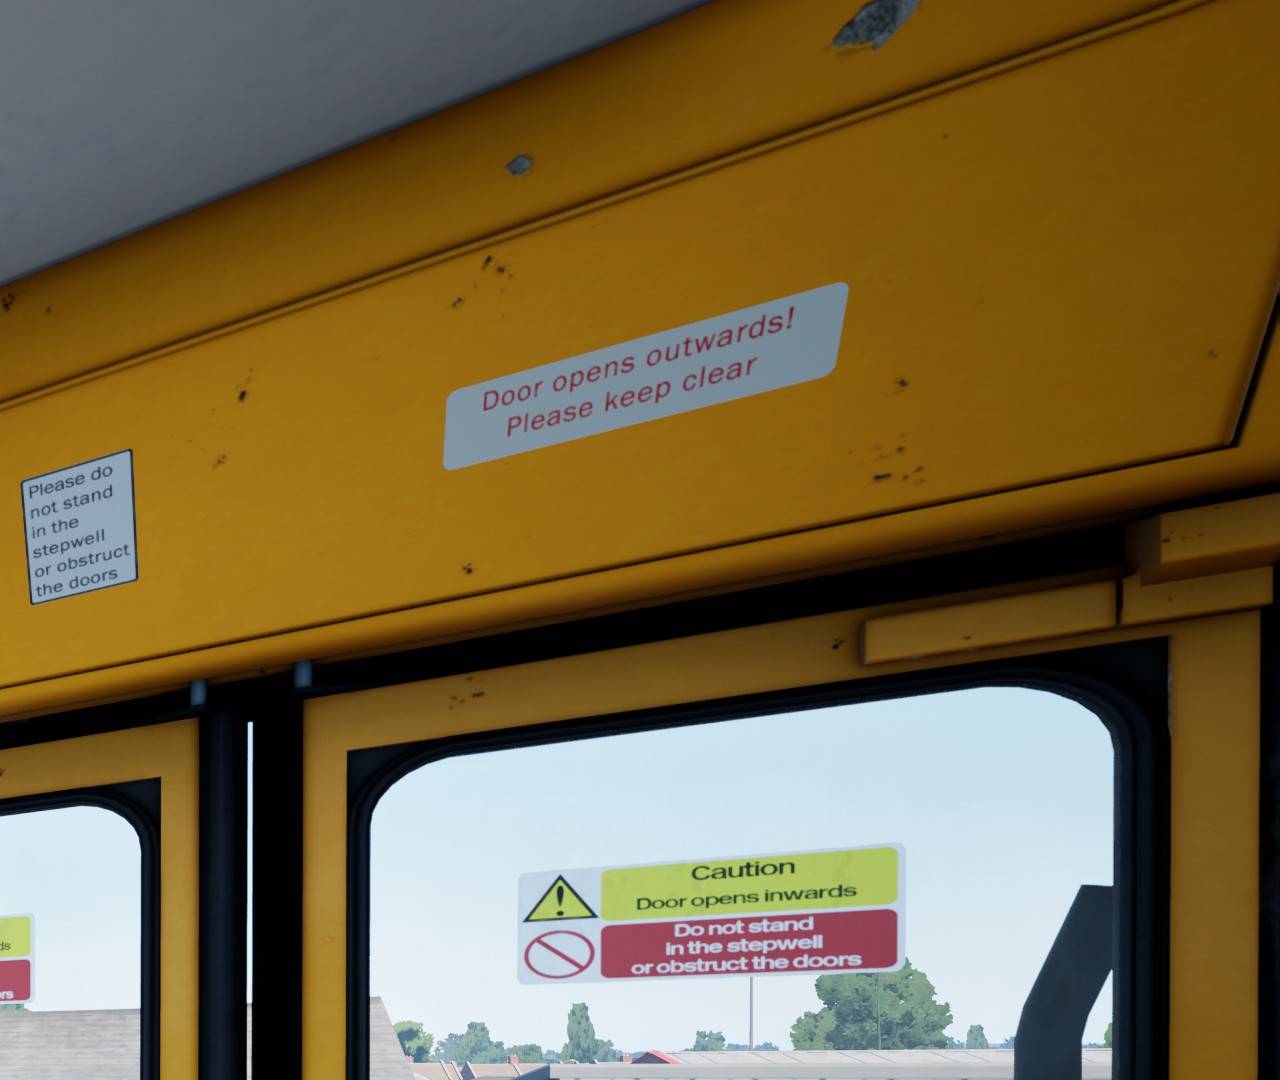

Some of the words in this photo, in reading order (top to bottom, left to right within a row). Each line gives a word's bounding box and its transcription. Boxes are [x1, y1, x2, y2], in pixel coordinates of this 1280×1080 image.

[483, 381, 543, 412] Door
[552, 354, 635, 393] opens
[645, 306, 796, 367] outwards!
[506, 400, 594, 437] Please
[604, 382, 672, 413] keep
[682, 356, 759, 393] clear
[29, 474, 85, 499] Please
[90, 465, 113, 481] do
[30, 501, 58, 519] not
[63, 484, 113, 511] stand
[32, 526, 46, 539] in
[51, 517, 79, 534] the
[32, 528, 105, 559] stepwell
[34, 564, 51, 578] or
[57, 543, 131, 573] obstruct
[36, 581, 64, 597] the
[68, 568, 119, 589] doors
[691, 860, 795, 881] Caution
[636, 894, 687, 911] Door
[691, 890, 759, 911] opens
[764, 883, 857, 902] inwards
[674, 922, 706, 938] Do
[709, 919, 746, 937] not
[749, 916, 814, 933] stand
[666, 941, 684, 956] in
[686, 939, 723, 955] the
[726, 935, 824, 956] stepwell
[631, 961, 654, 975] or
[656, 955, 751, 974] obstruct
[753, 955, 790, 971] the
[792, 952, 862, 969] doors
